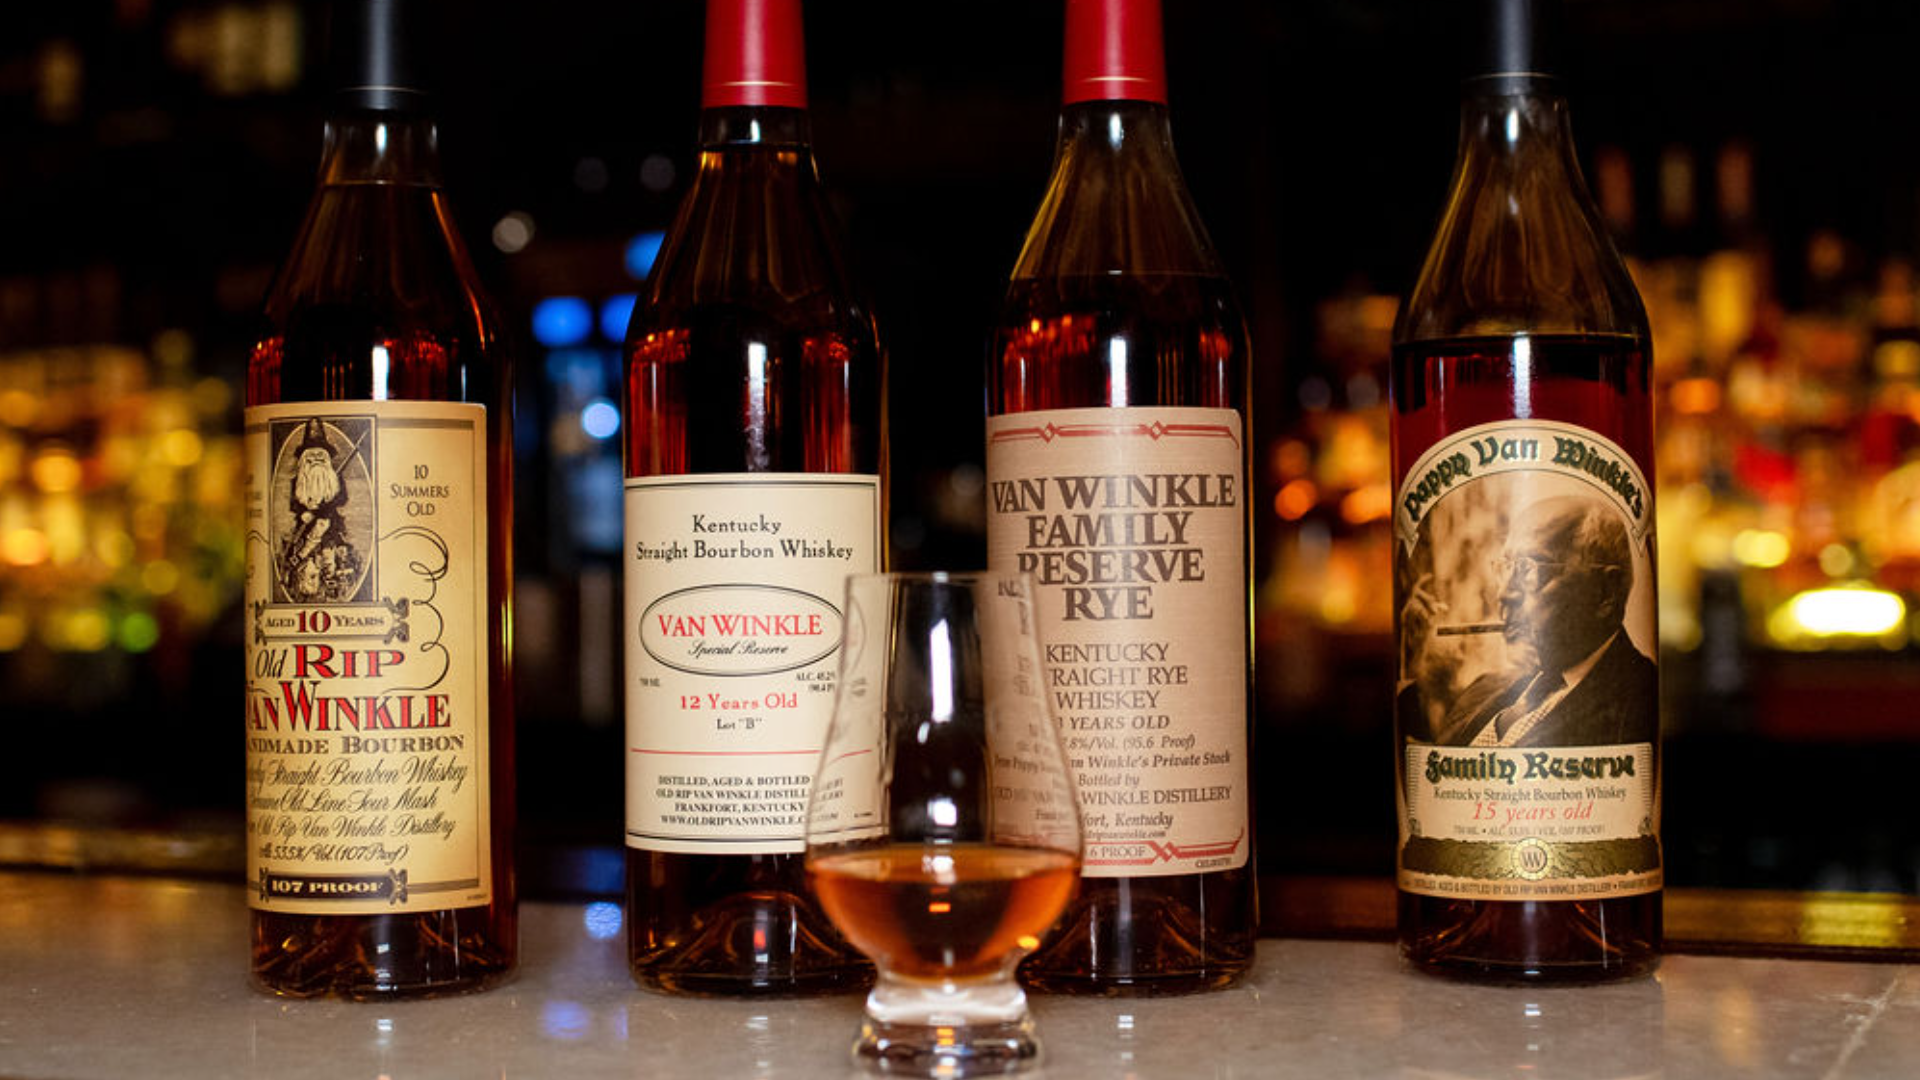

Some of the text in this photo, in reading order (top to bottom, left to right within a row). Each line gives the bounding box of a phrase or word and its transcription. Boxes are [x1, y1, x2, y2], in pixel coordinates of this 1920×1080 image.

[414, 465, 430, 479] 10
[1470, 437, 1539, 466] Van
[1552, 436, 1644, 519] Winkle's
[390, 484, 450, 499] SUMMERS
[992, 474, 1236, 513] VAN WINKLE
[692, 514, 782, 535] Kentucky
[1026, 511, 1194, 549] FAMILY
[636, 539, 854, 564] Straight Bourbon Whiskey
[1017, 549, 1206, 585] RESERVE
[1062, 586, 1154, 621] RYE
[265, 611, 385, 633] AGED 10 YEARS
[658, 615, 824, 637] VAN WINKLE
[688, 641, 789, 660] Special Reserve
[1045, 643, 1169, 664] KENTUCKY
[255, 644, 406, 679] Old RIP
[1147, 665, 1188, 686] RYE
[279, 680, 452, 732] WINKLE
[680, 693, 798, 710] 12 Years Old
[1055, 690, 1160, 710] WHISKEY
[716, 718, 736, 730] Lot
[1069, 715, 1126, 730] YEARS
[1131, 714, 1171, 730] OLD
[250, 734, 464, 755] NDMADE BOURBON
[1161, 734, 1196, 751] Proof)
[1088, 754, 1150, 768] Winkle's
[1152, 753, 1202, 768] Private
[1203, 750, 1231, 765] Stock
[1425, 750, 1636, 785] Family Reserve
[322, 757, 399, 787] Bourbon
[403, 755, 468, 793] Whiskey
[711, 776, 743, 786] AGED
[757, 776, 811, 786] BOTTLED
[1078, 773, 1140, 789] Bottled by
[393, 786, 440, 811] Mash
[656, 787, 809, 799] OLD RIP VAN WINKLE DISTILL
[1080, 785, 1232, 806] WINKLE DISTILLERY
[1433, 787, 1627, 804] Kentucky Straight Bourbon Whiskey
[674, 801, 805, 813] FRANKFORT, KENTUCKY
[1472, 802, 1595, 830] 15 years old
[331, 815, 389, 838] Winkle
[390, 811, 457, 841] Distillery
[661, 815, 806, 826] WWW.OLDRIPVANWINKLE.C
[1082, 811, 1174, 829] fort, Kentucky
[1101, 846, 1146, 858] PROOF
[271, 879, 385, 893] 107 PROOF
